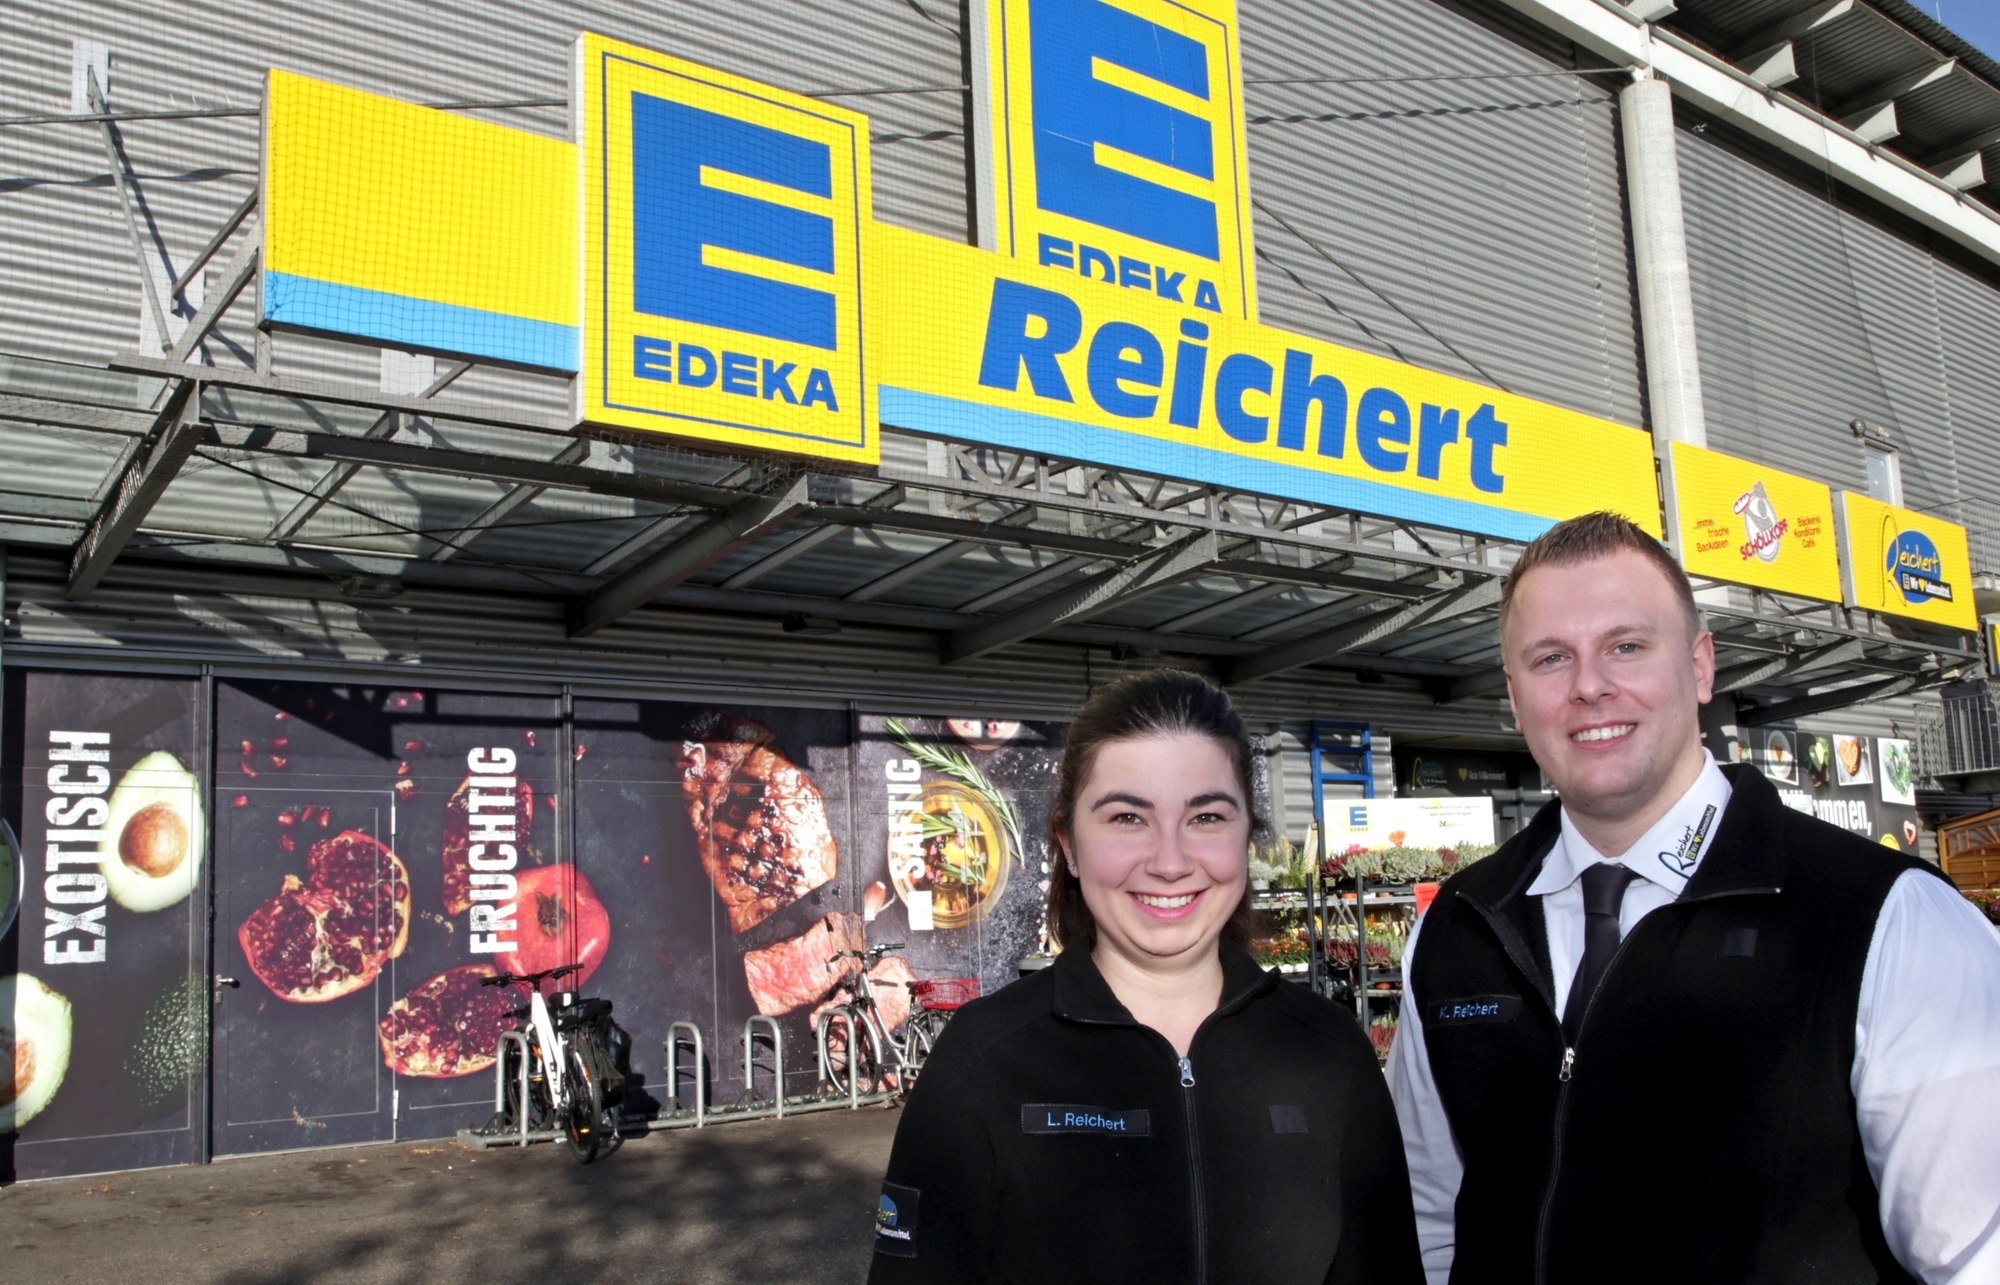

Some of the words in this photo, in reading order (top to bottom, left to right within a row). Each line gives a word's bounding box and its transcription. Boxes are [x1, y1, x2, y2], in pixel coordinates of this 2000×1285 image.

[1029, 0, 1219, 262] E
[630, 90, 838, 352] E
[1037, 232, 1222, 314] EDEKA
[632, 333, 840, 413] EDEKA
[977, 275, 1508, 494] Reichert
[1696, 538, 1729, 553] Backideen
[1740, 518, 1788, 561] SCHÖLLKOPF
[1794, 525, 1821, 539] Konditorei
[44, 730, 110, 964] EXOTISCH
[467, 747, 518, 954] FRUCHTIG
[885, 758, 926, 879] SAFTIG
[1439, 1005, 1450, 1019] K.
[1453, 1002, 1499, 1019] Reichert
[1047, 1112, 1061, 1126] L.
[1065, 1112, 1126, 1131] Reichert
